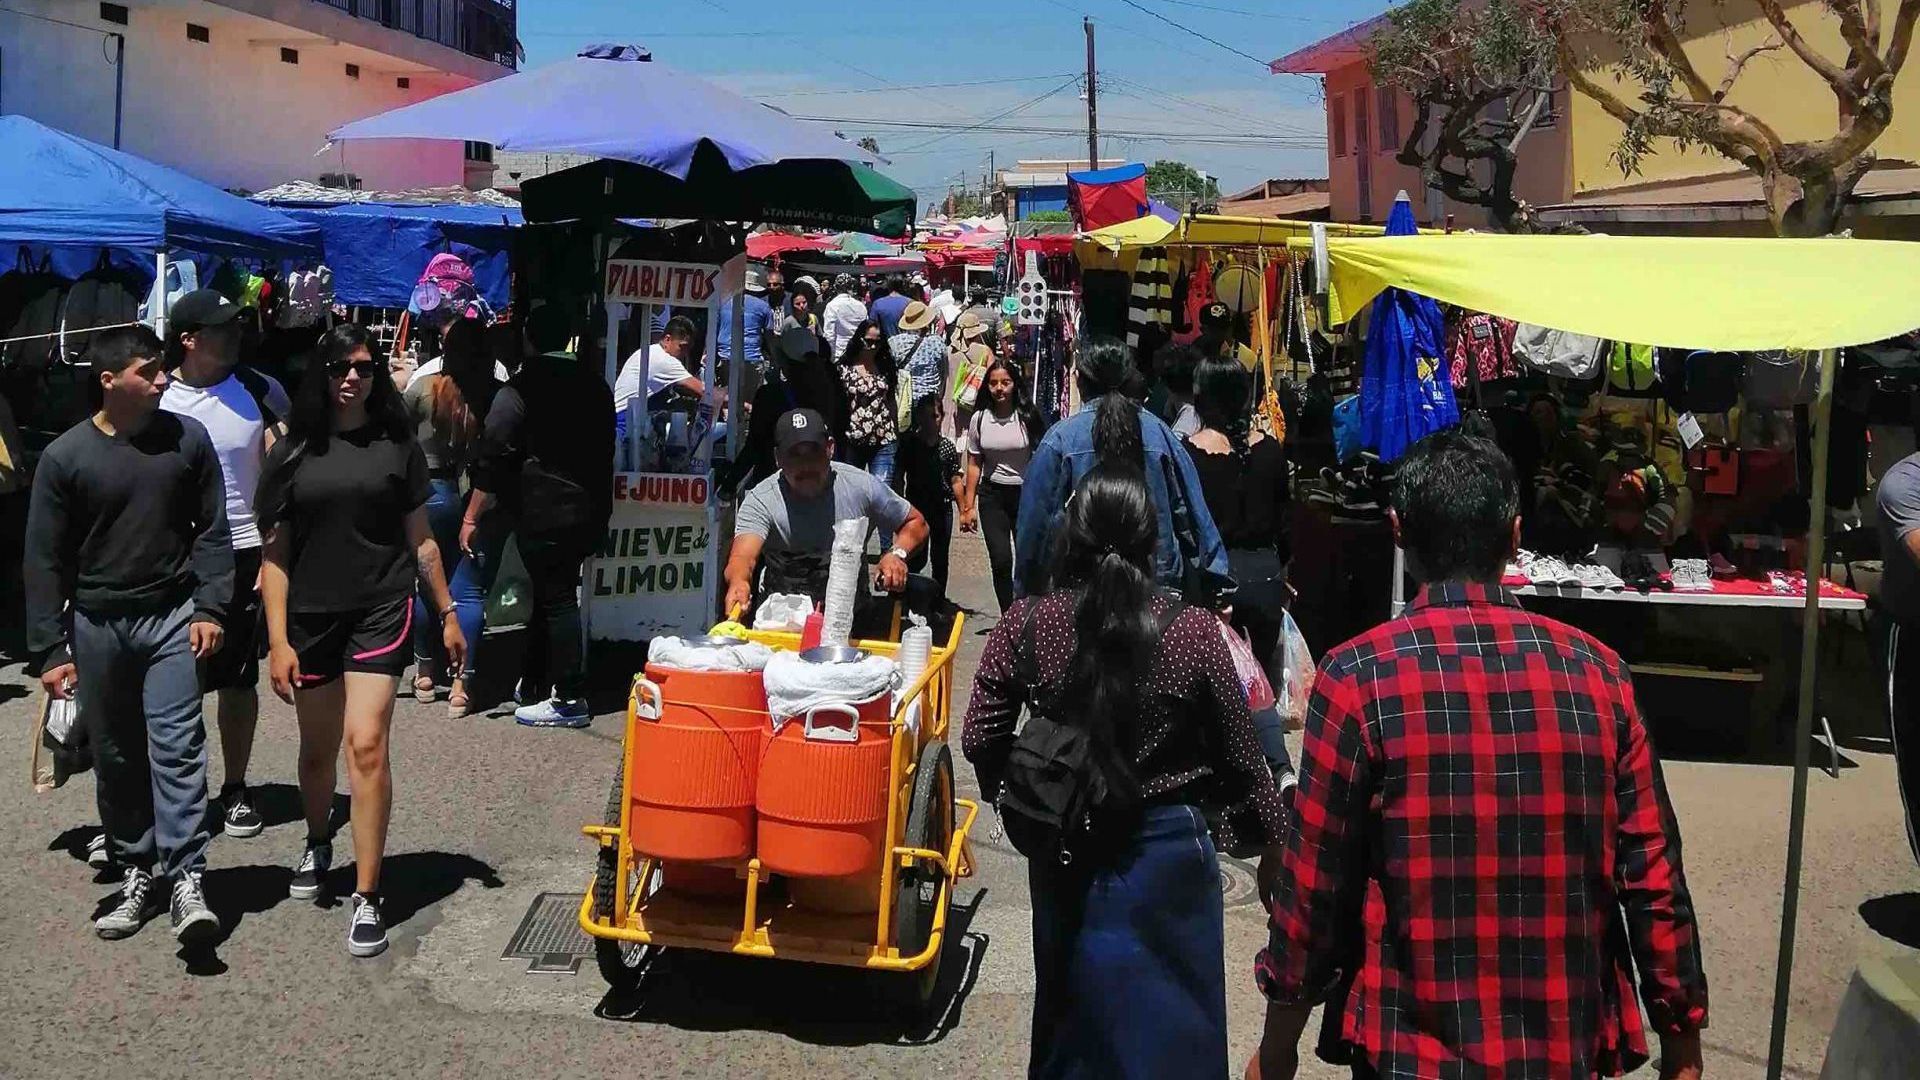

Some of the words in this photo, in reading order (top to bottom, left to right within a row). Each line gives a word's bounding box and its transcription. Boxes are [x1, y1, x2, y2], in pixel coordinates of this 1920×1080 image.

[762, 208, 833, 221] STARBUCKS
[607, 264, 720, 300] DIABLITOS
[614, 475, 708, 504] EJUINO
[596, 526, 693, 559] NIEVE
[594, 562, 704, 596] LIMON
